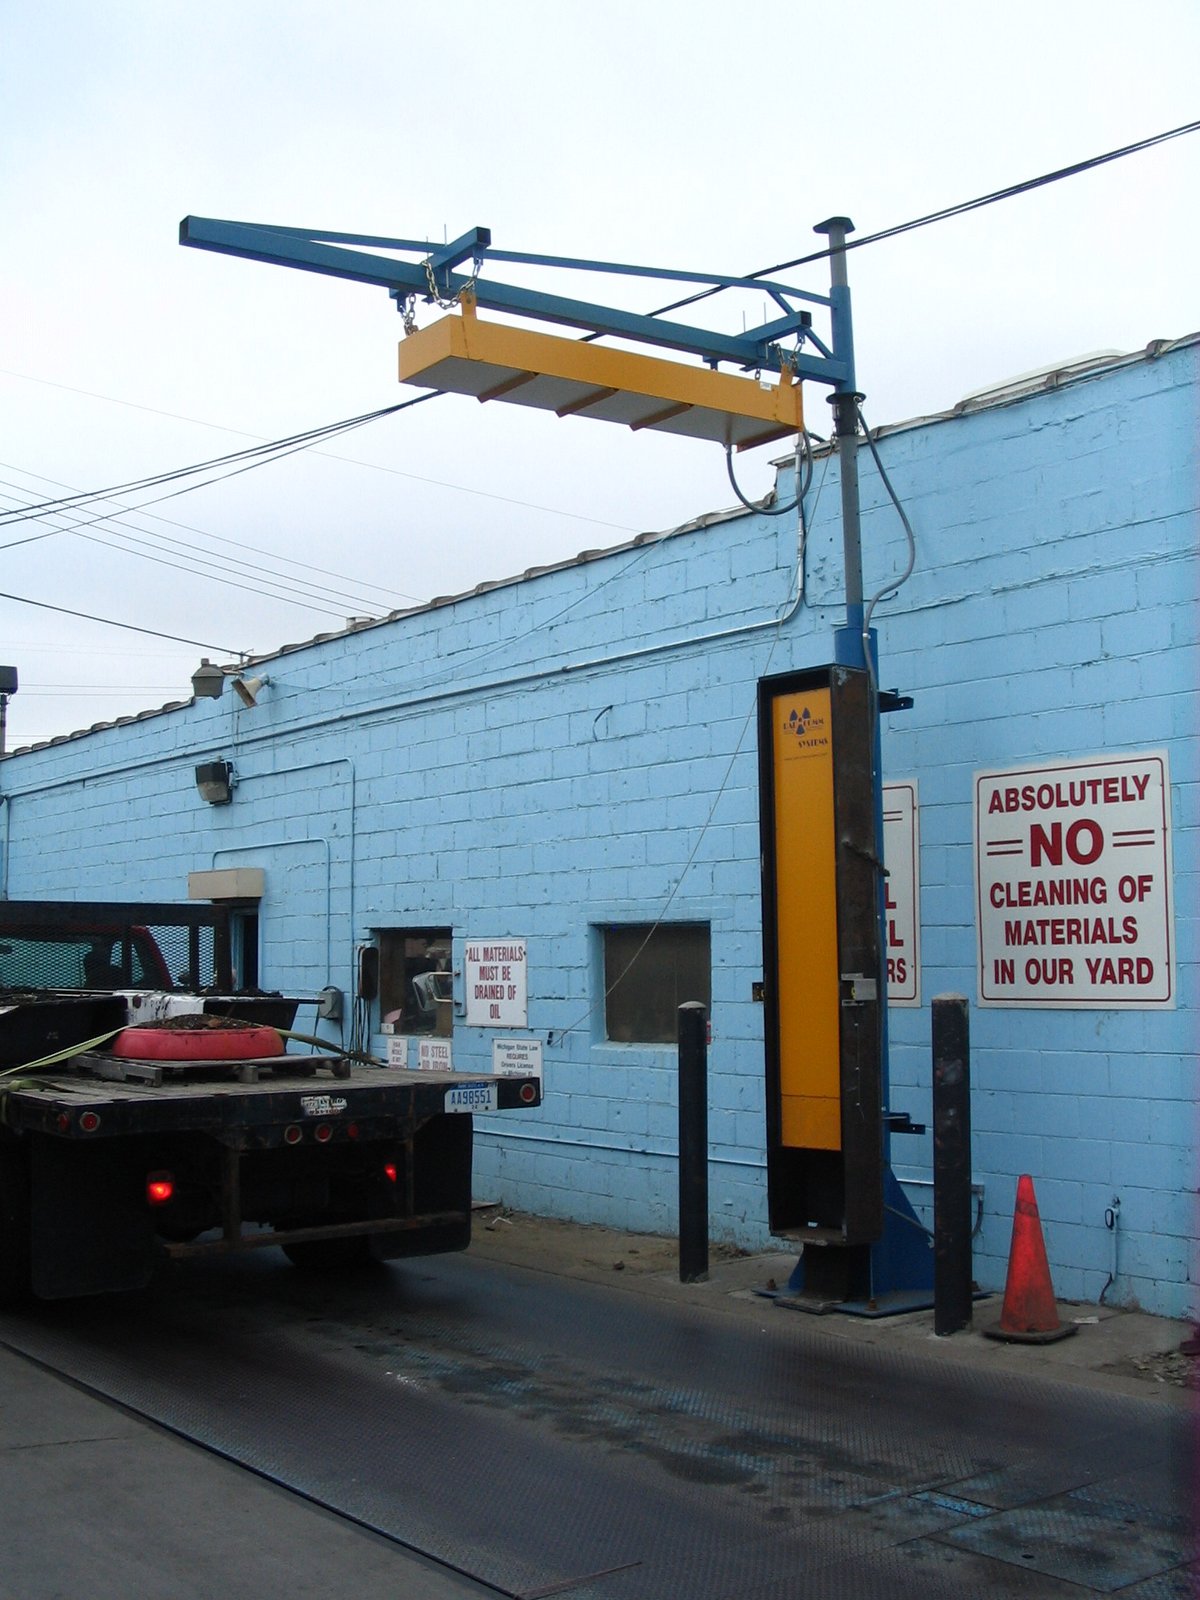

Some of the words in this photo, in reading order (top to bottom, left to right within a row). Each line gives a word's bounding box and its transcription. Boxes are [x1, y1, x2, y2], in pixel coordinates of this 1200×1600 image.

[988, 773, 1151, 814] ABSOLUTELY
[1030, 818, 1104, 867] NO
[989, 877, 1107, 909] CLEANING
[1118, 874, 1153, 903] OF
[1004, 916, 1138, 946] MATERIALS
[468, 947, 480, 962] ALL
[483, 946, 523, 962] MATERIALS
[479, 966, 499, 981] MUST
[502, 966, 511, 981] BE
[994, 958, 1015, 985] IN
[1025, 957, 1074, 985] OUR
[1084, 957, 1154, 985] YARD
[475, 985, 504, 1000] DRAINED
[508, 985, 517, 1000] OF
[490, 1004, 501, 1019] OIL
[421, 1045, 429, 1057] NO
[431, 1045, 448, 1059] STEEL
[497, 1043, 515, 1051] Michigan
